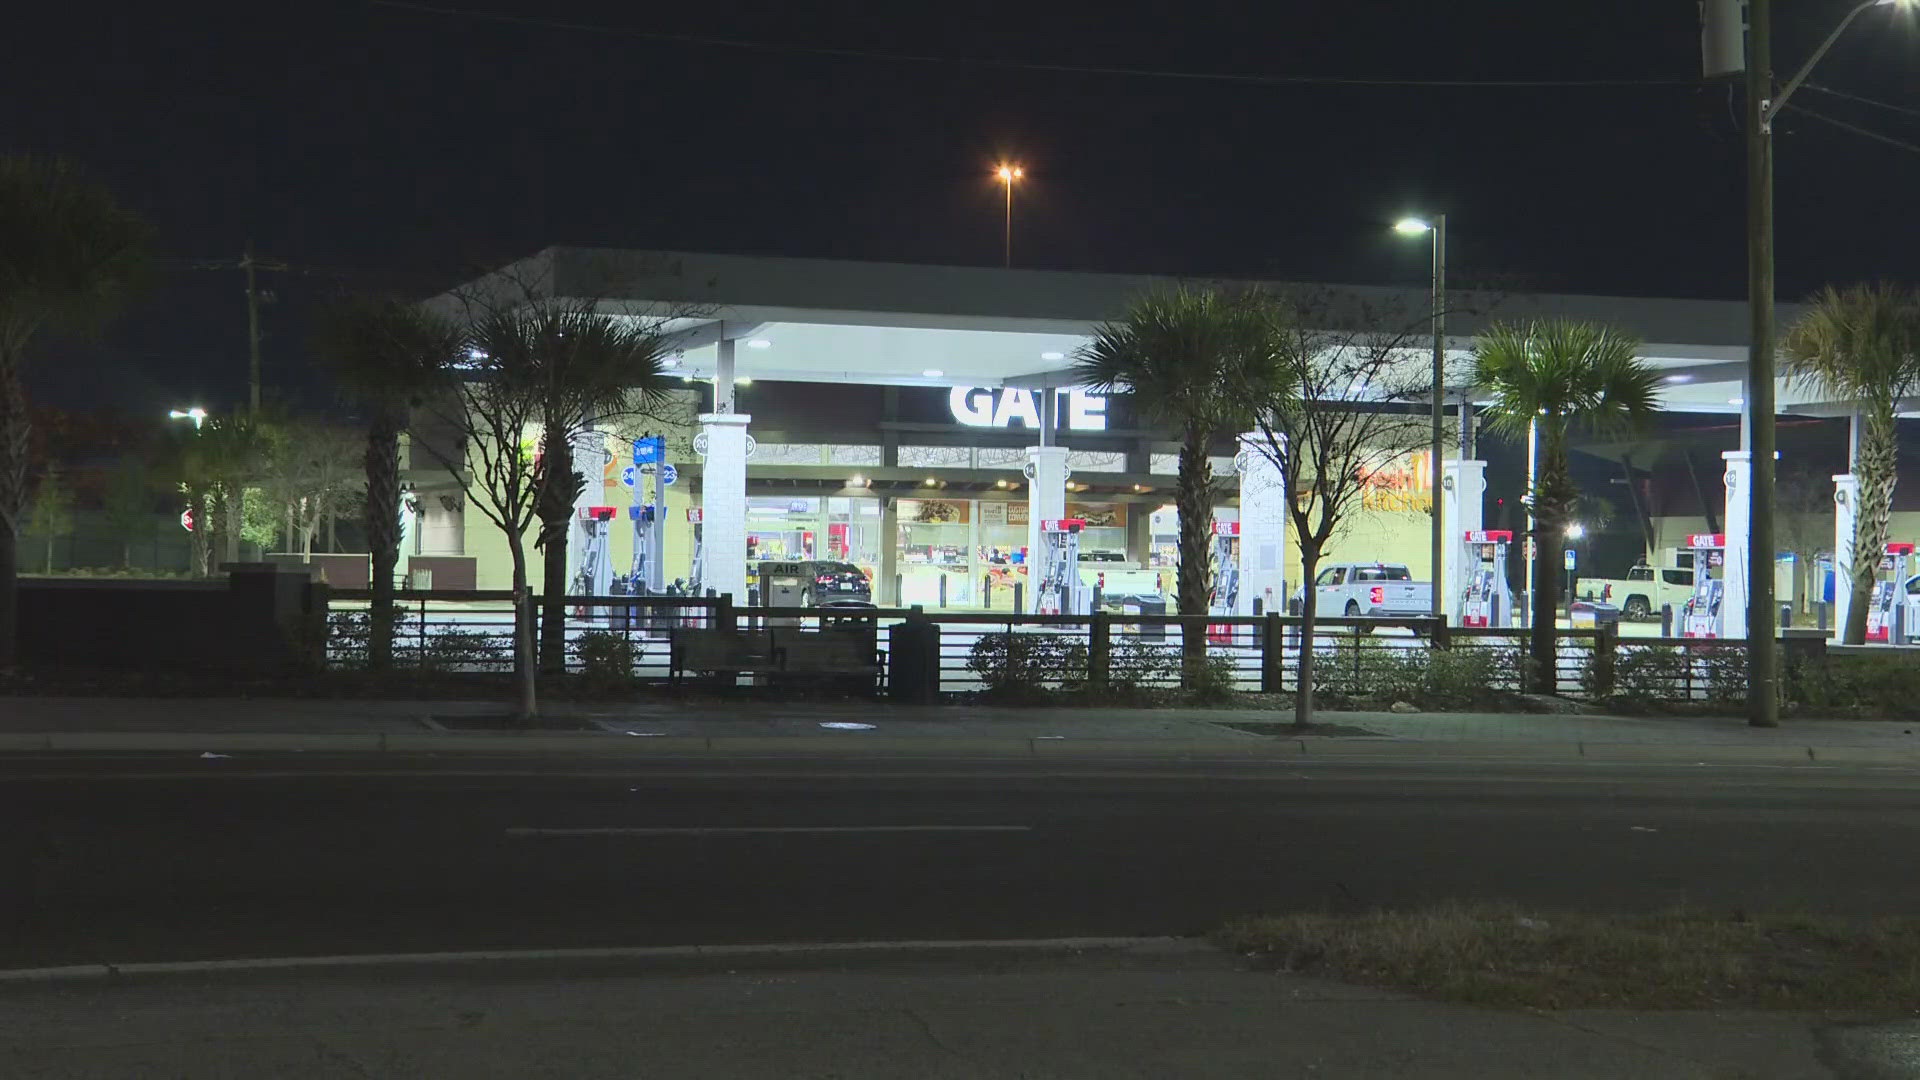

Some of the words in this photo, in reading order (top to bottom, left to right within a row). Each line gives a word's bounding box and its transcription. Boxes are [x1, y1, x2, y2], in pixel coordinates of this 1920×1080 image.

[950, 386, 1106, 430] GAE
[696, 439, 707, 449] 20
[1025, 466, 1034, 474] 14
[623, 471, 634, 480] 24
[1726, 473, 1736, 482] 12
[1044, 520, 1059, 531] GATE
[1216, 522, 1232, 534] GATE
[1469, 531, 1487, 542] GATE
[1693, 535, 1715, 547] GATE
[774, 564, 799, 573] AIR
